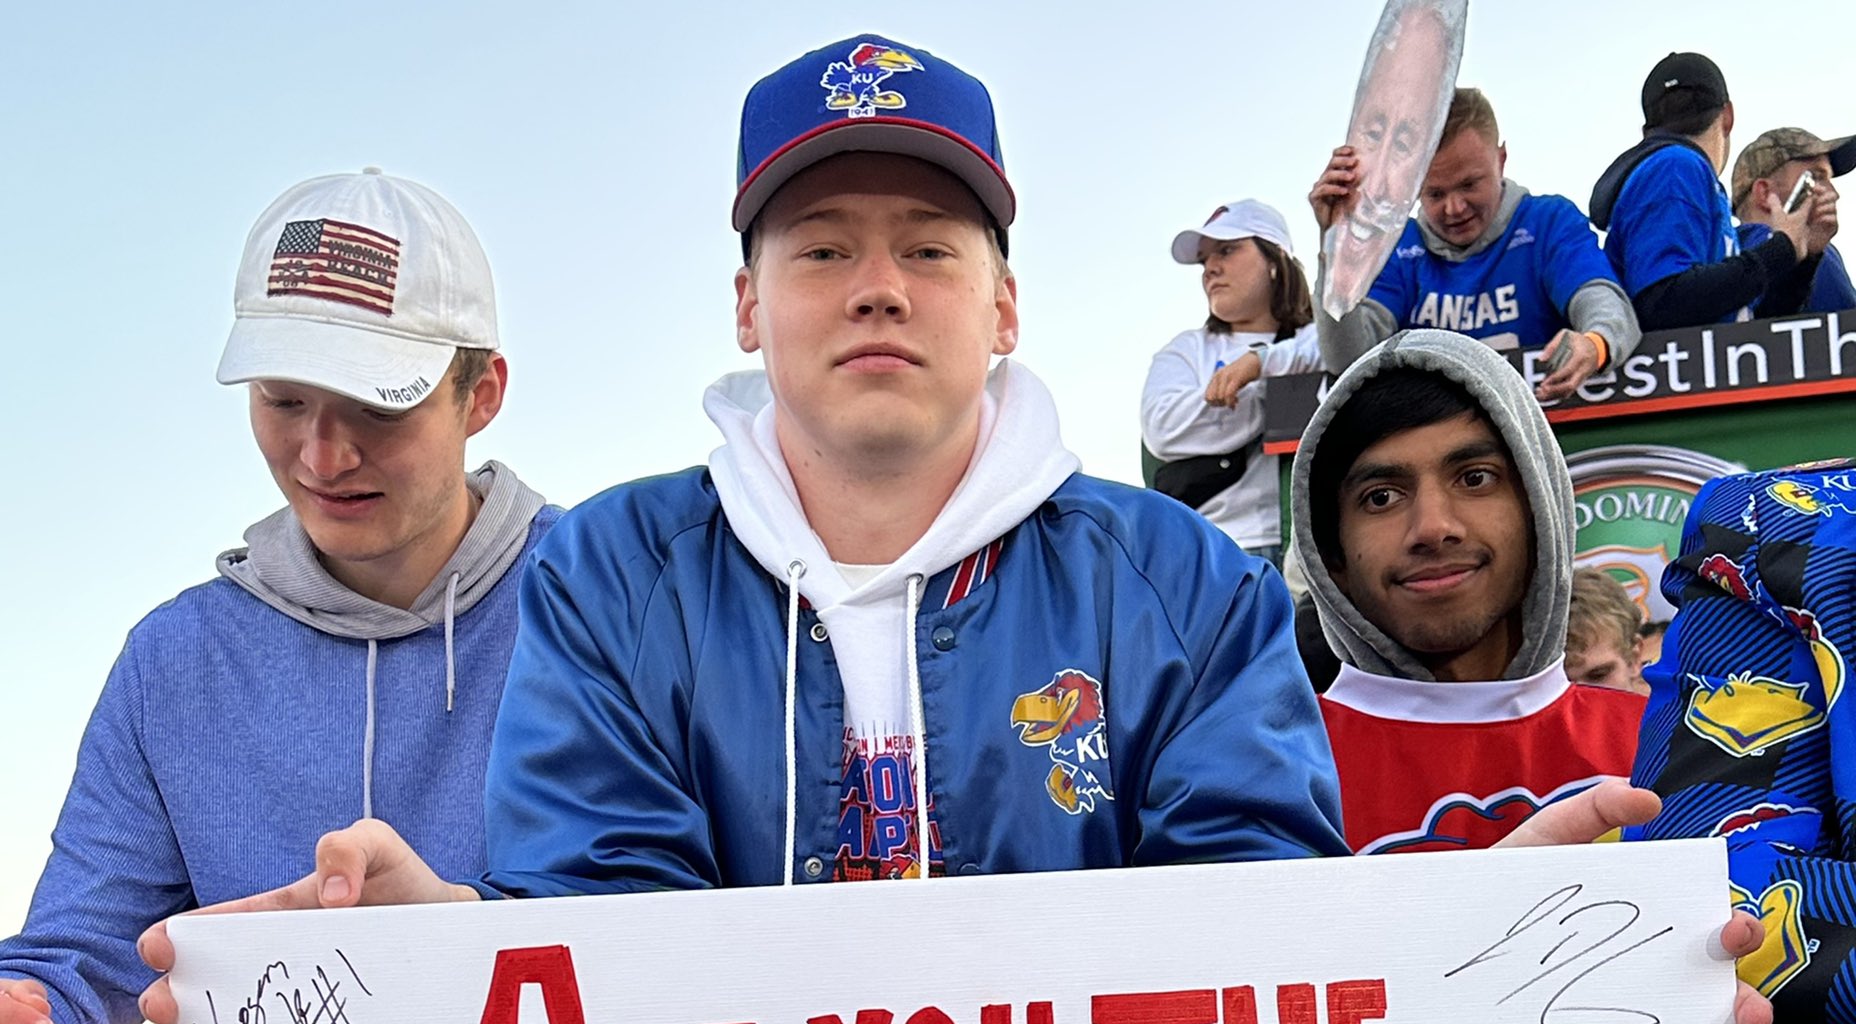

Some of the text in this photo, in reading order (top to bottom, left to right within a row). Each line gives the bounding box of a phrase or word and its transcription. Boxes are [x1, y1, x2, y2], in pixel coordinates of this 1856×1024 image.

[851, 73, 873, 83] KU
[1410, 284, 1519, 331] ANSAS
[375, 376, 431, 404] VIRGINIA
